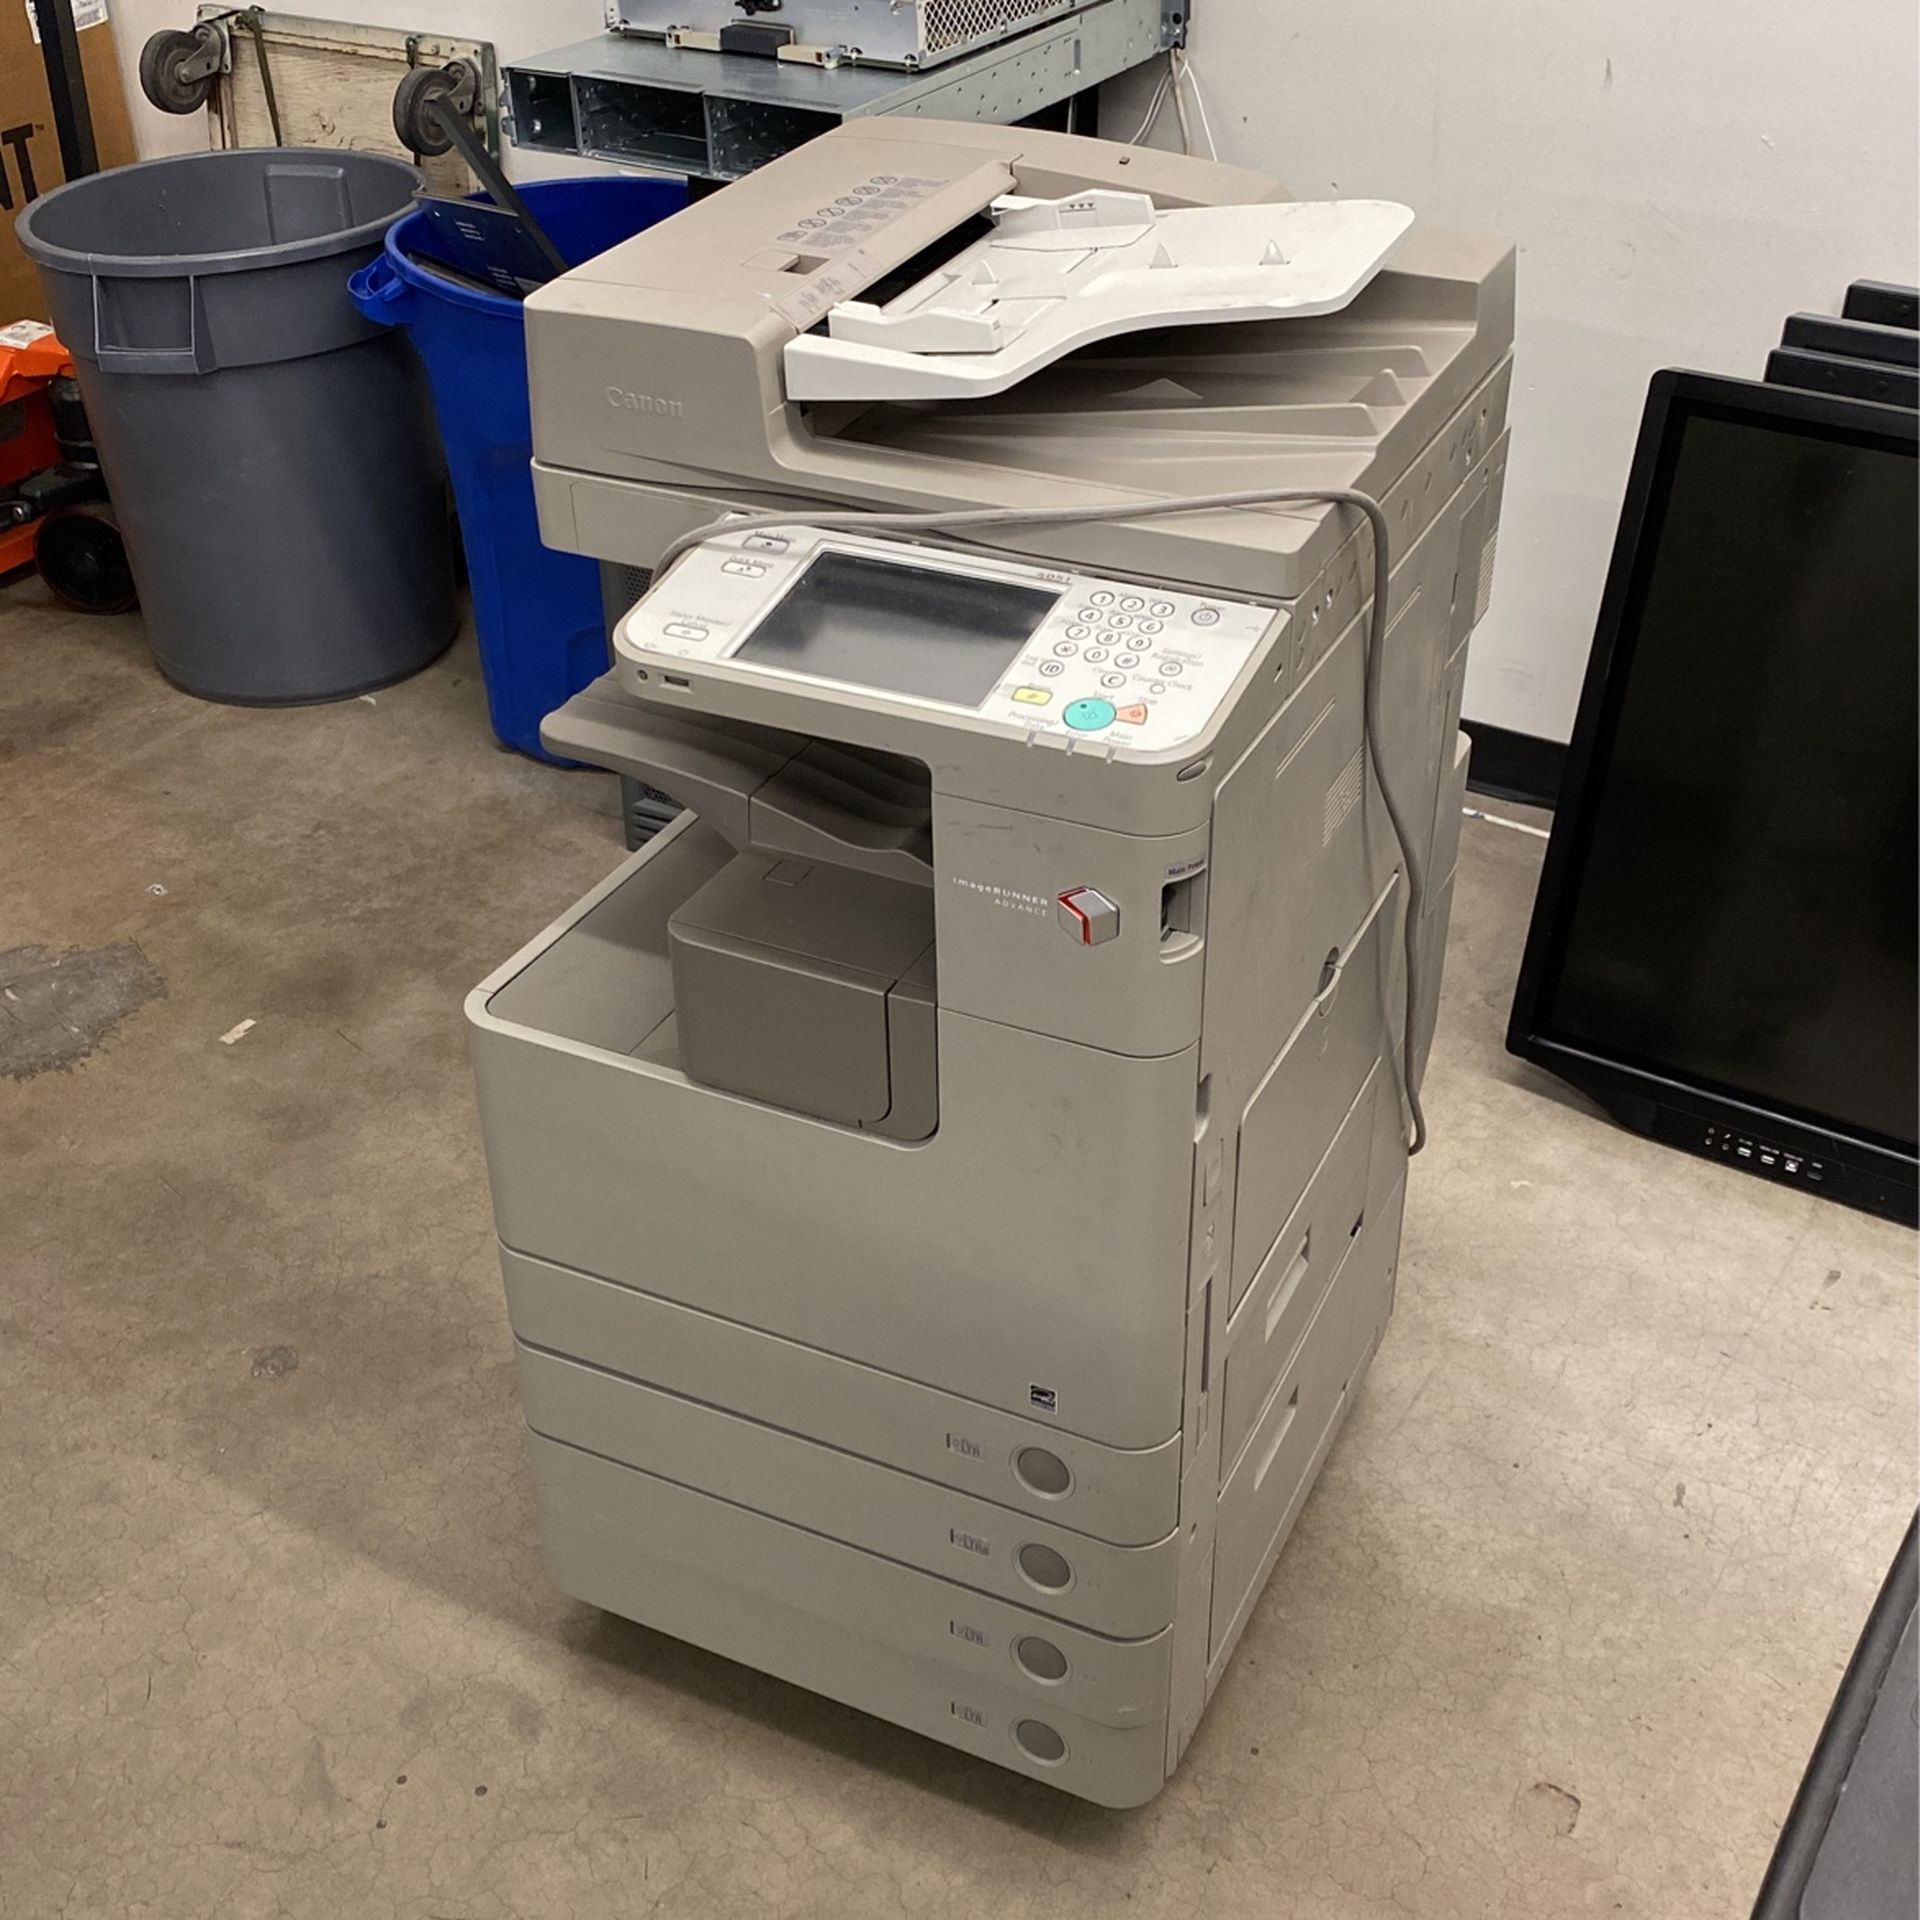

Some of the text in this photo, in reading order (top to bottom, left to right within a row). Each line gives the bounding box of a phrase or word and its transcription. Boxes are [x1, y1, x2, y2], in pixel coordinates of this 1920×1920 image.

[605, 386, 684, 417] Canon
[1044, 663, 1061, 674] ID
[952, 876, 1049, 908] imageRUNNER
[994, 898, 1048, 918] ADVANCE
